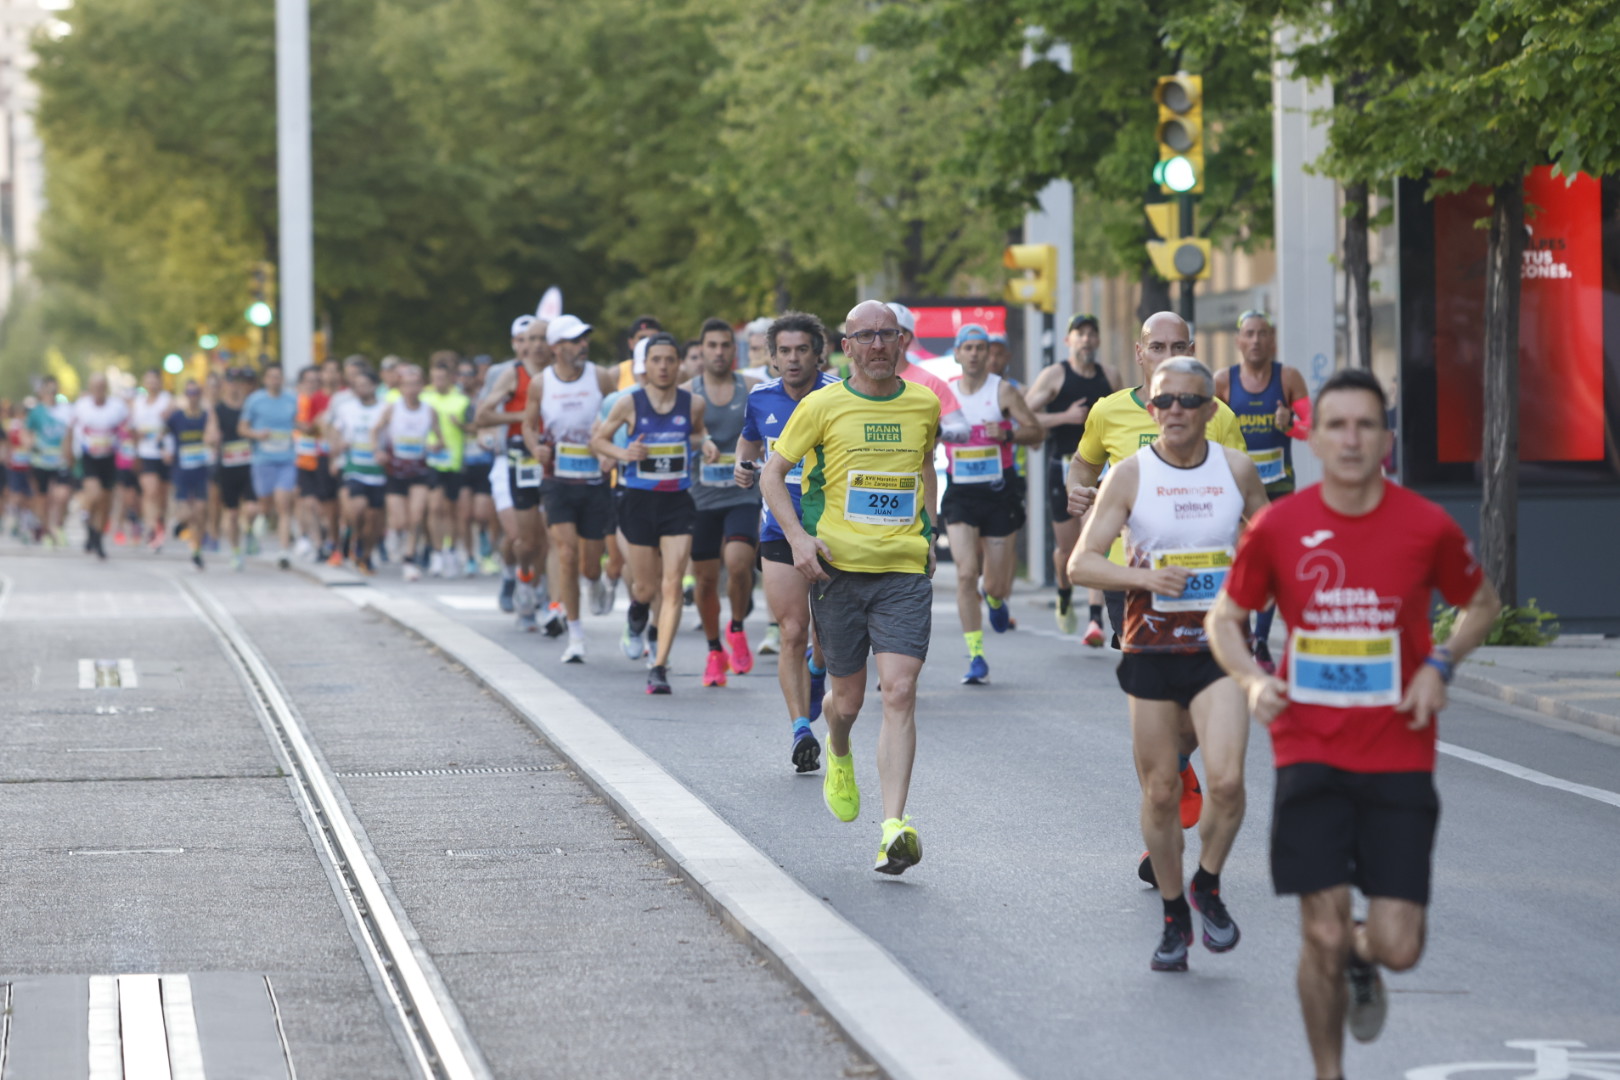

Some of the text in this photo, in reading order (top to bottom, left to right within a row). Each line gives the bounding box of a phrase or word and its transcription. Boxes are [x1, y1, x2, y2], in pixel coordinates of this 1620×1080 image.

[1523, 250, 1553, 264] TUS
[866, 425, 899, 433] MANN
[867, 433, 900, 441] FILTER
[868, 494, 899, 509] 296
[1314, 587, 1380, 606] MEDIA
